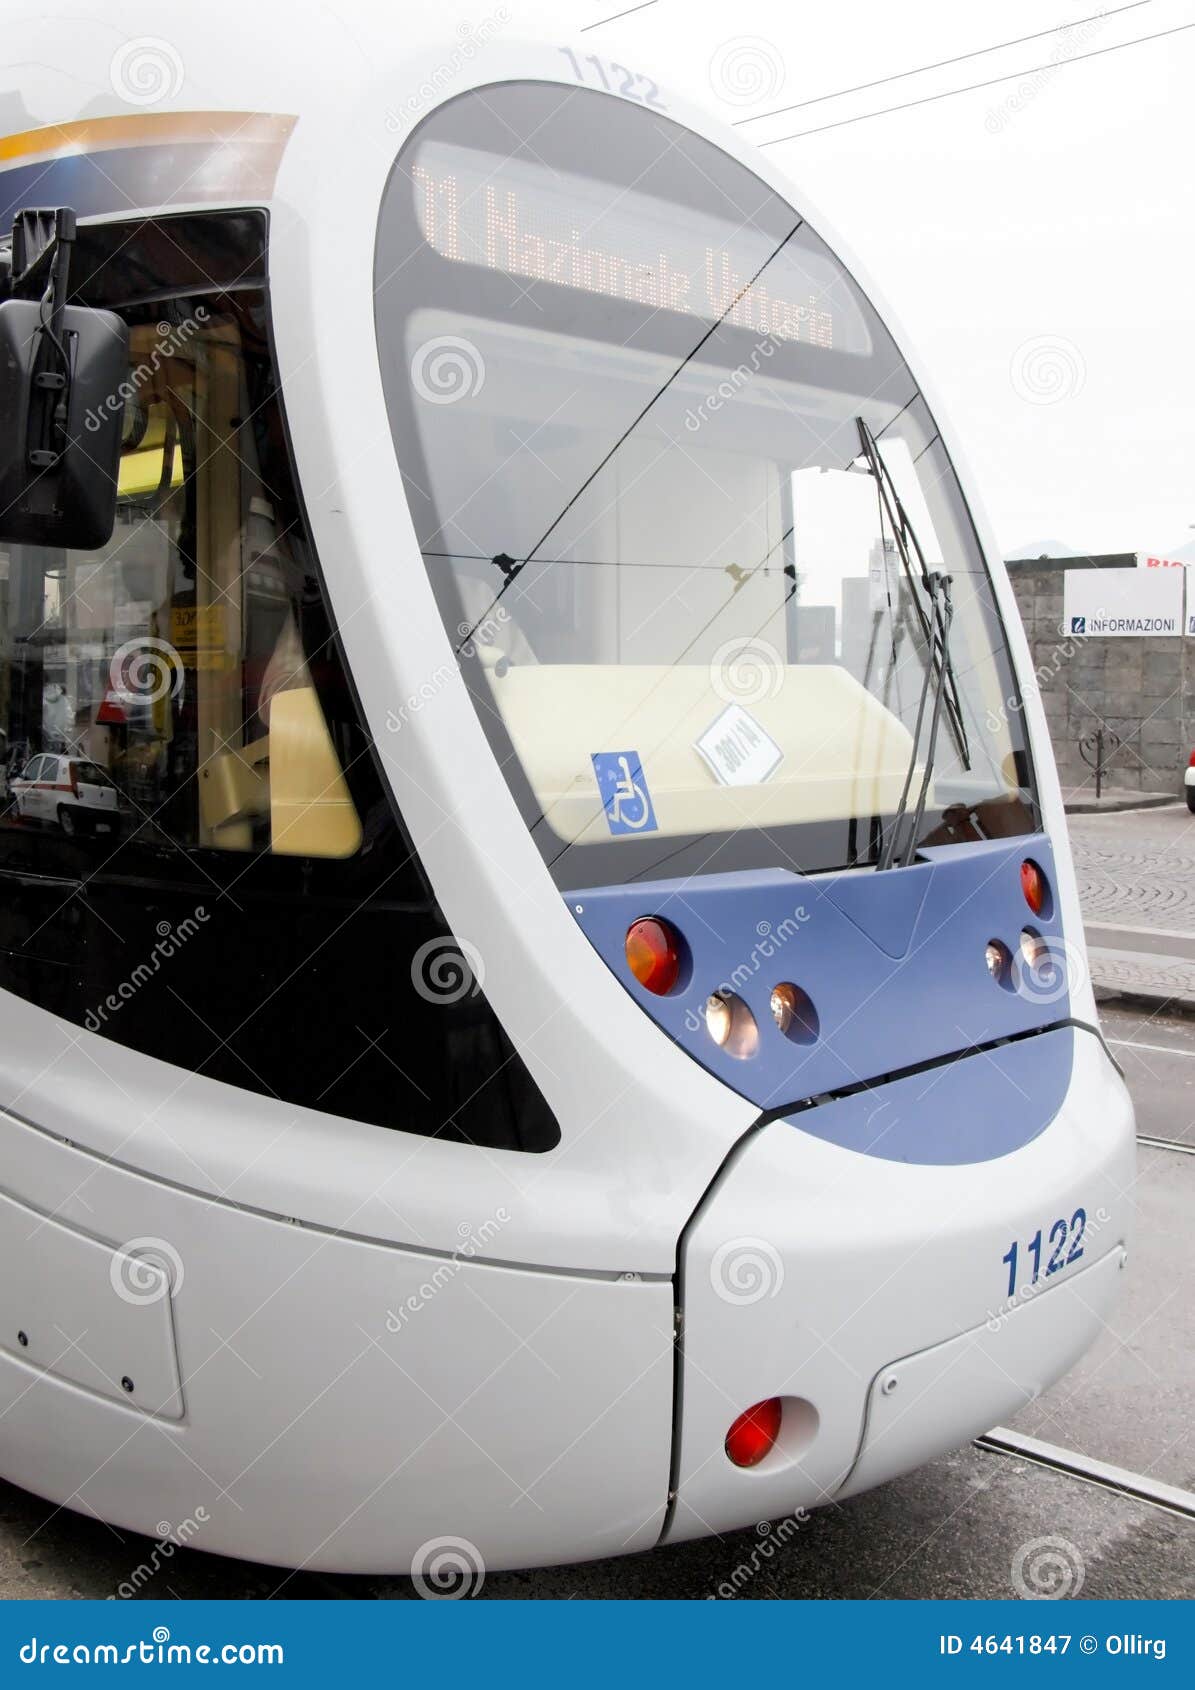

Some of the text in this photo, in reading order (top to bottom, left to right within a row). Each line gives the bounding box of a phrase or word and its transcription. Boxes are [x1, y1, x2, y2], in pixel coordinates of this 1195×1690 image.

[558, 46, 669, 111] 1122
[487, 186, 690, 312] Nazionale
[1090, 619, 1174, 632] INFORMAZIONI
[1003, 1208, 1086, 1297] 1122
